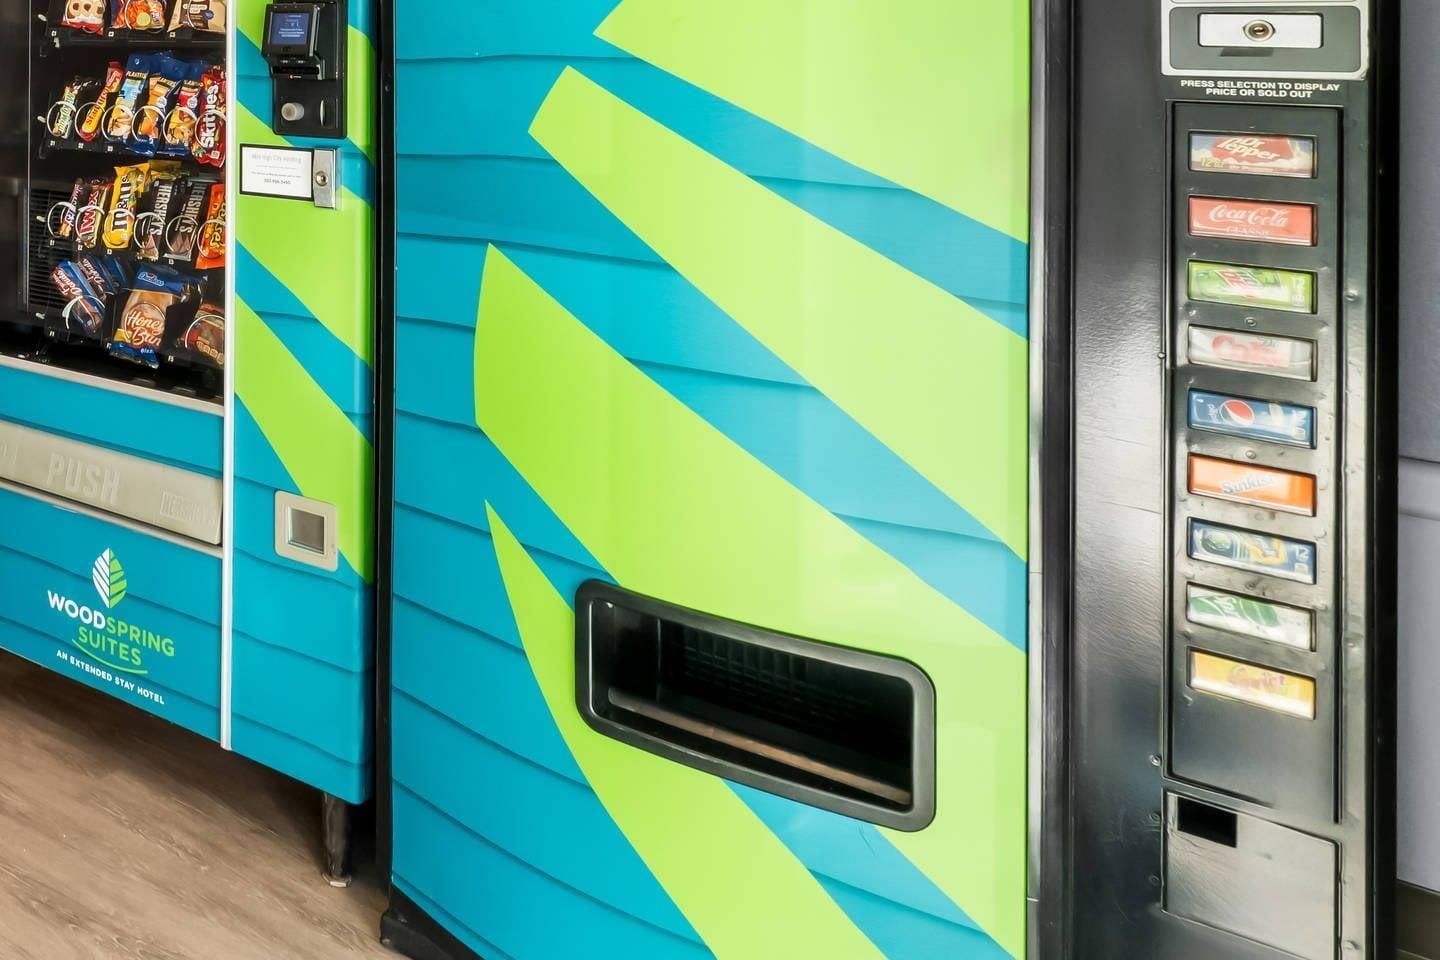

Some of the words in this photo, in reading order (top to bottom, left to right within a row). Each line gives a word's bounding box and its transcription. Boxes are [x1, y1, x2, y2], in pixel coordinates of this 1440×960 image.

[1181, 79, 1215, 88] PRESS
[1216, 80, 1277, 90] SELECTION
[1277, 82, 1292, 90] TO
[1294, 83, 1340, 91] DISPLAY
[1206, 88, 1237, 97] PRICE
[1239, 89, 1256, 97] OR
[1257, 89, 1288, 97] SOLD
[1289, 90, 1313, 98] OUT
[47, 454, 121, 506] PUSH
[47, 590, 175, 657] WOODSPRING
[78, 626, 142, 666] SUITES
[57, 650, 68, 660] AN
[70, 655, 113, 682] EXTENDED
[115, 677, 135, 691] STAY
[137, 686, 165, 705] HOTEL
